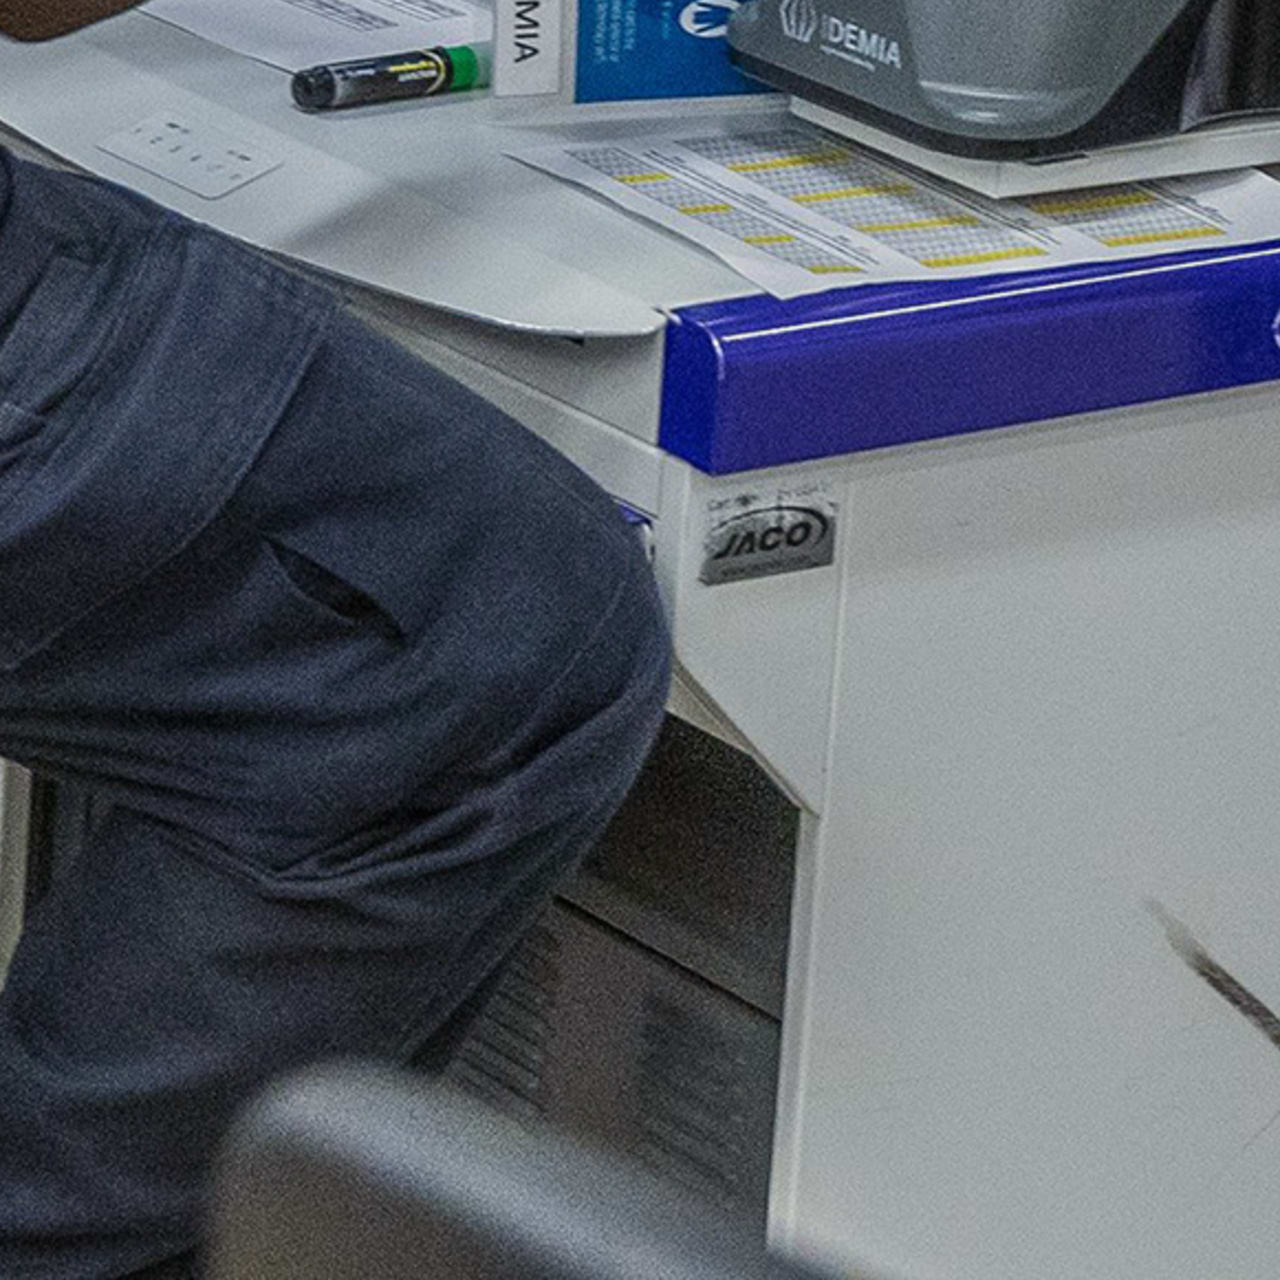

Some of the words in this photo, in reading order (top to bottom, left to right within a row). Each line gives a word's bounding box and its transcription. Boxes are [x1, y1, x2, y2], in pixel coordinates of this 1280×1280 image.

[514, 0, 540, 63] MIA
[820, 14, 902, 69] IDEMIA
[712, 520, 813, 560] JACO
